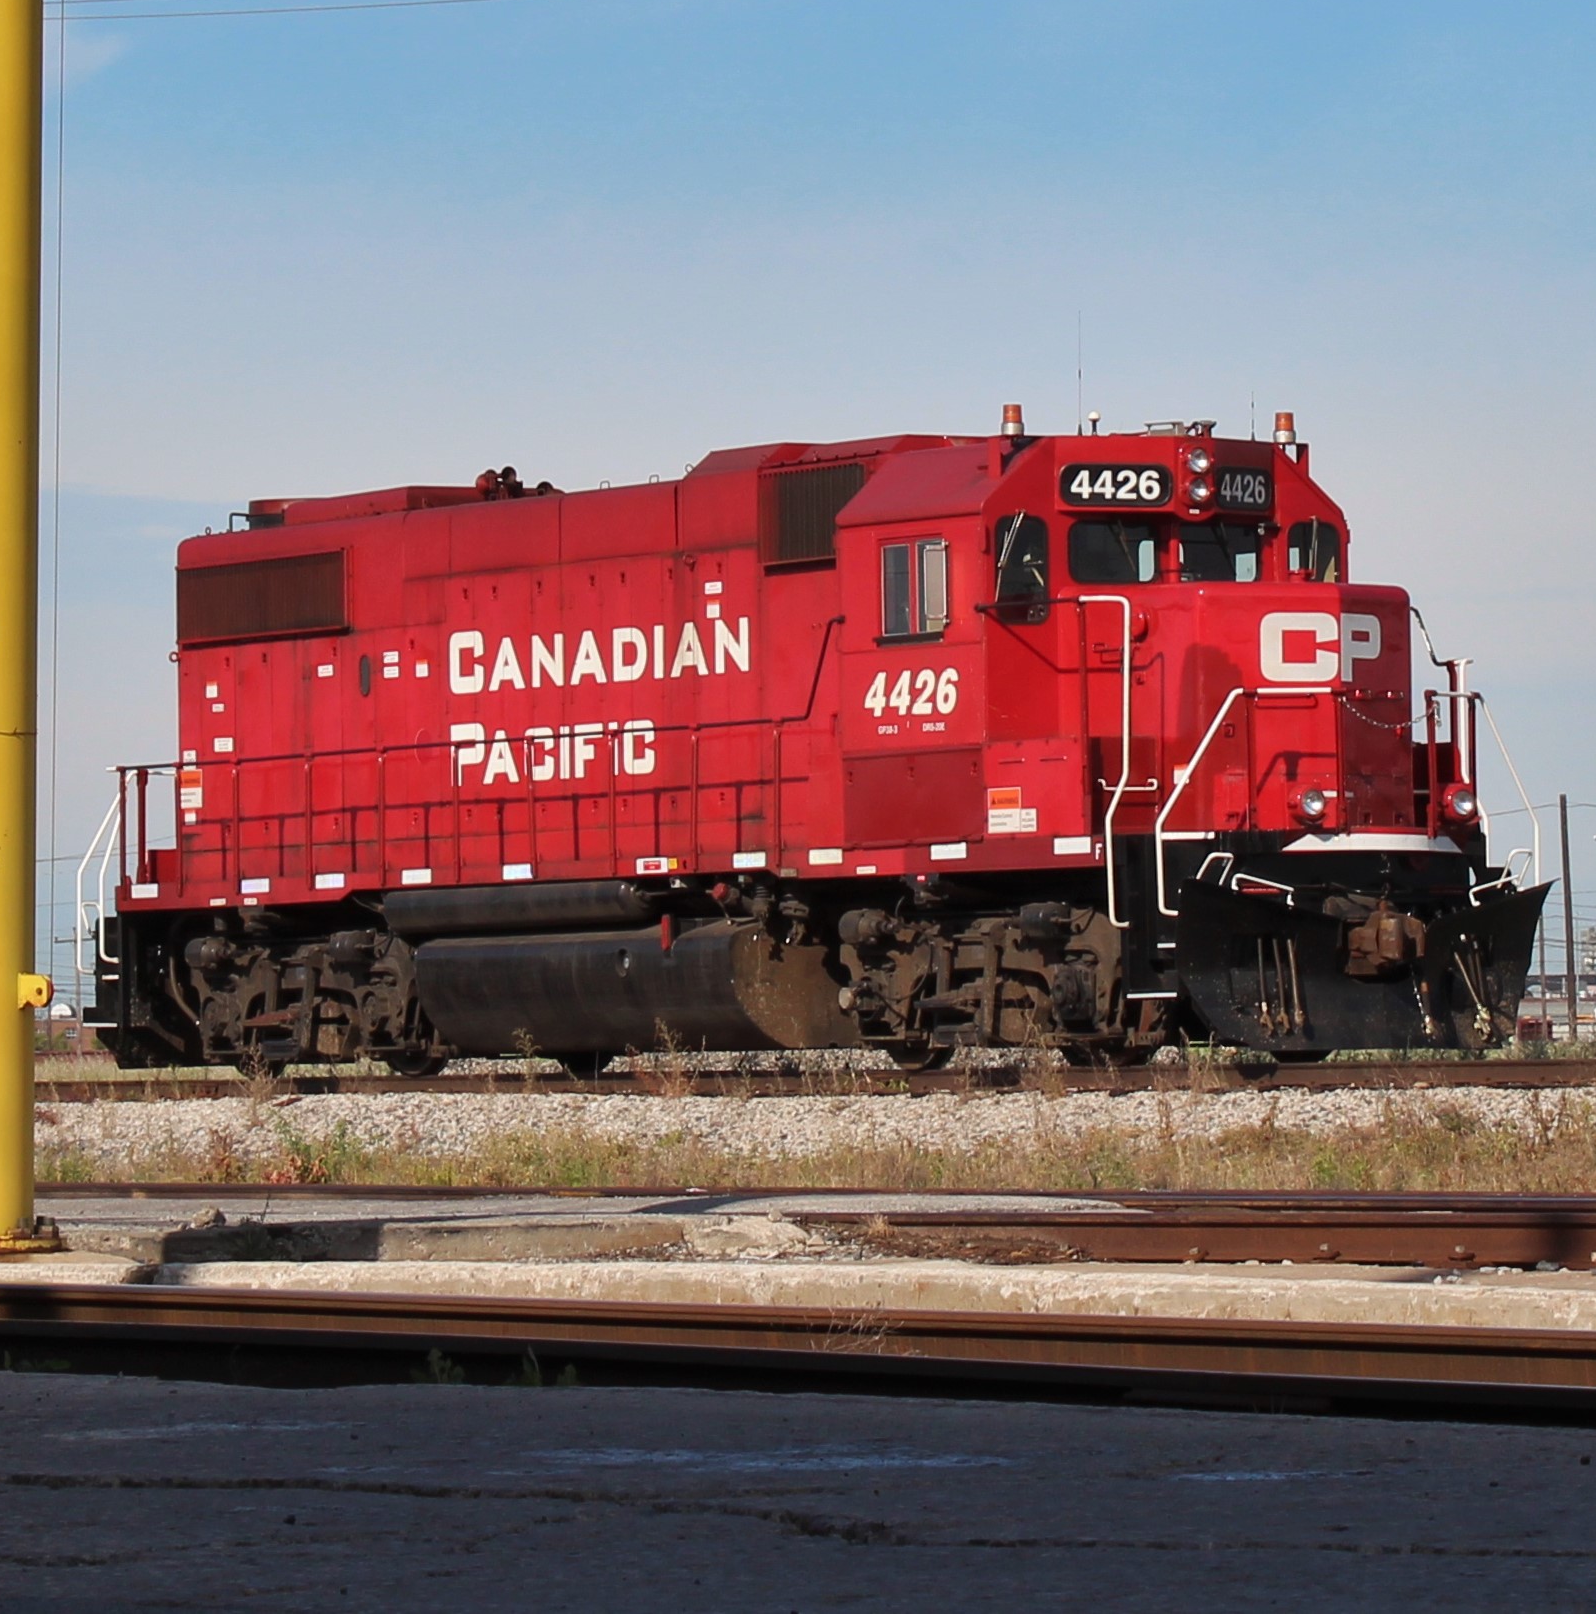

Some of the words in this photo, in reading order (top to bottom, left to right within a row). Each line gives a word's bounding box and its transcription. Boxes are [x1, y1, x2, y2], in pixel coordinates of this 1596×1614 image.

[1070, 469, 1161, 501] 4426
[1220, 473, 1266, 504] 4426
[449, 616, 750, 695] CANADIAN
[1260, 612, 1382, 683] CP
[864, 667, 959, 717] 4426
[450, 719, 655, 787] PACIFIC
[1095, 843, 1103, 860] F
